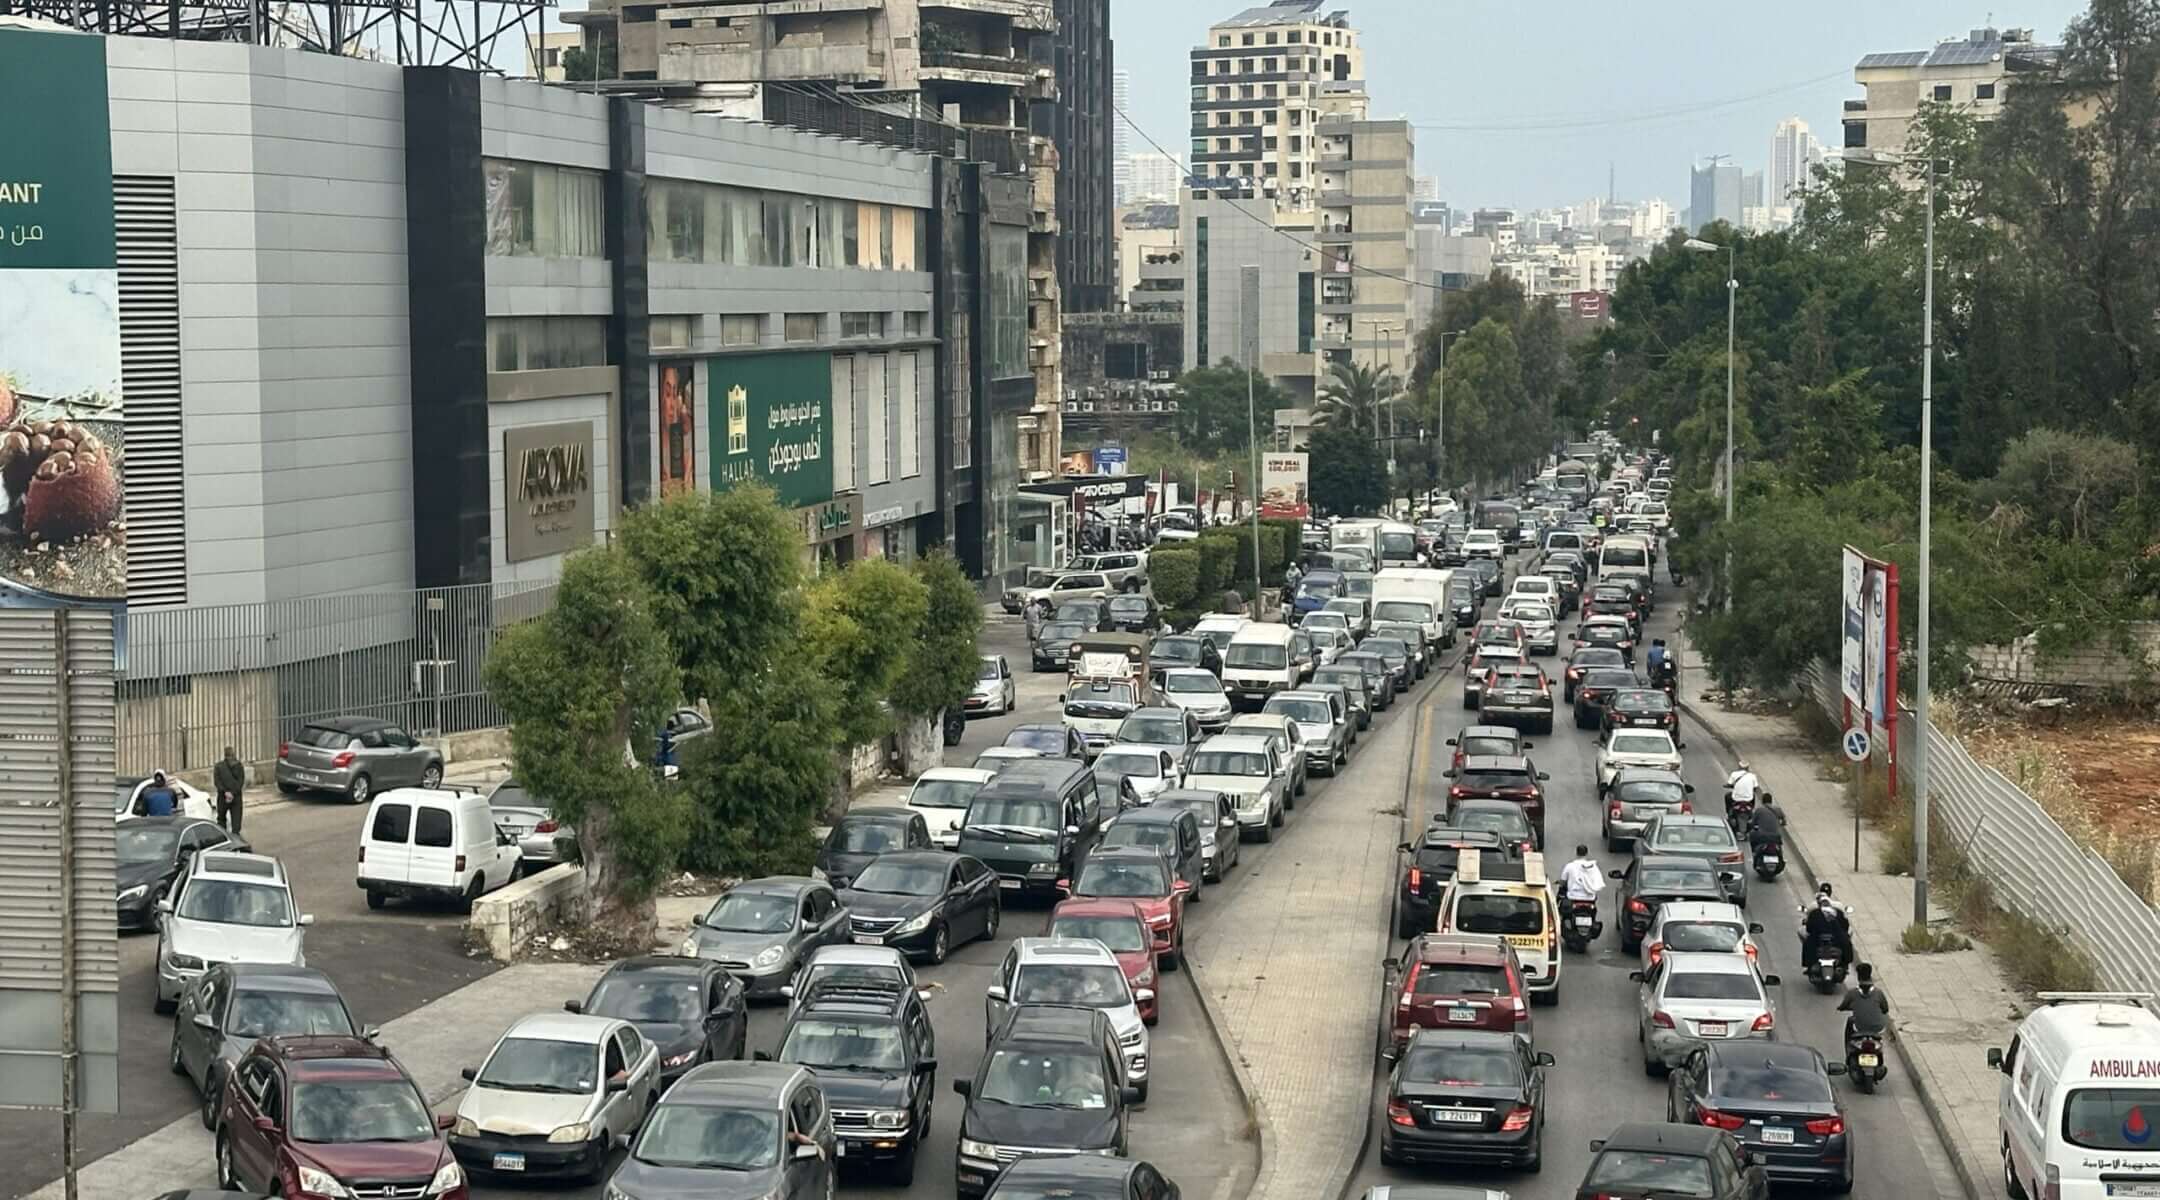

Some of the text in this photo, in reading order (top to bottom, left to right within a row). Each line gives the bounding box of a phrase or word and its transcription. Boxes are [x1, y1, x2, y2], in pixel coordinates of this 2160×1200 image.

[0, 183, 42, 204] ANT
[11, 225, 43, 246] من
[517, 442, 588, 502] AROMA
[722, 458, 754, 484] HALLAB
